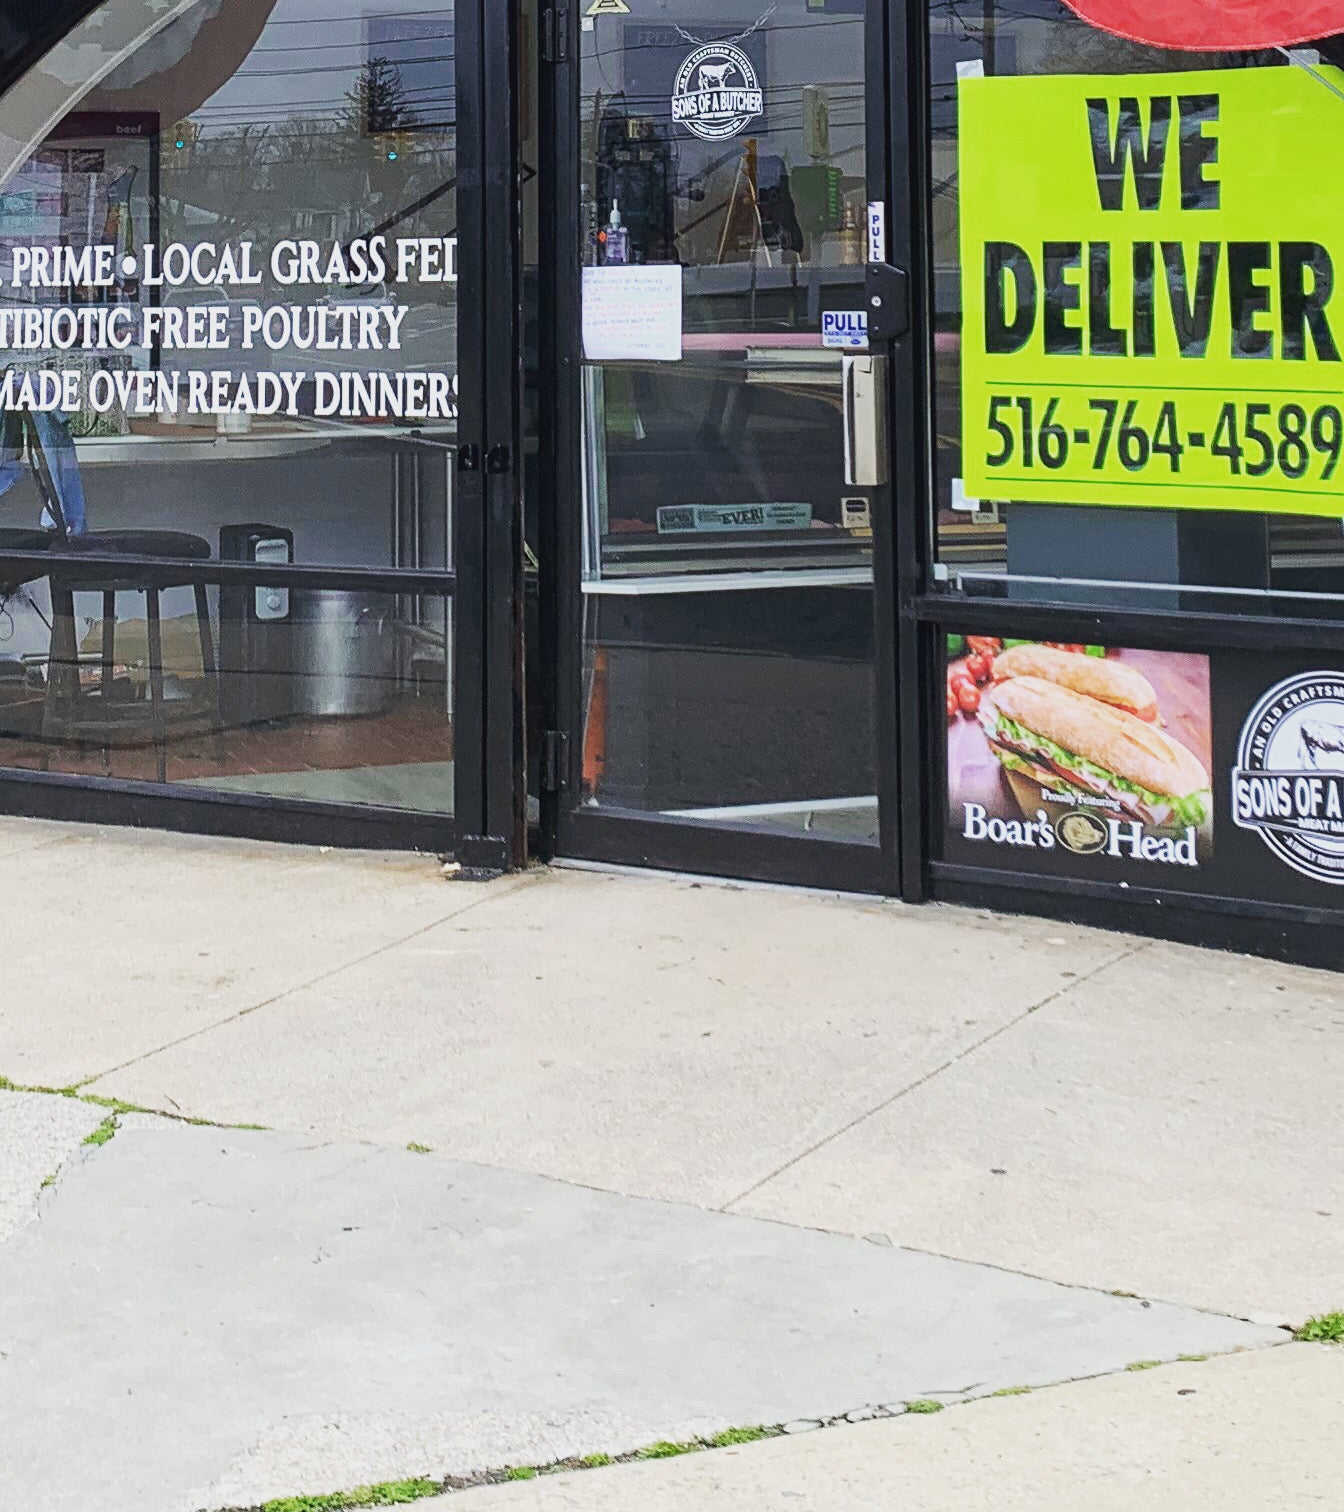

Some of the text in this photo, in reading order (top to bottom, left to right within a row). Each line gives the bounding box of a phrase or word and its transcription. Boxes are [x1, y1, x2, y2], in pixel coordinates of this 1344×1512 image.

[673, 96, 697, 119] SONS
[698, 93, 711, 113] OF
[712, 92, 719, 111] A
[720, 92, 761, 111] BUTCHER
[116, 124, 142, 134] beef
[1086, 94, 1221, 211] WE
[872, 215, 880, 260] PULL
[11, 245, 115, 287] PRIME
[142, 240, 261, 285] LOCAL
[271, 237, 386, 284] GRASS
[824, 314, 867, 331] PULL
[984, 240, 1341, 362] DELIVER
[142, 306, 230, 350] FREE
[243, 305, 408, 350] POULTRY
[89, 369, 178, 414] OVEN
[188, 370, 306, 414] READY
[986, 395, 1343, 481] 516-764-4589
[1252, 735, 1265, 759] AN
[1262, 709, 1284, 732] OLD
[1041, 788, 1123, 811] Proudly Featuring
[1238, 777, 1292, 818] SONS
[1294, 778, 1324, 816] OF
[1326, 780, 1342, 819] A
[962, 802, 1199, 866] Boar's Head
[1298, 817, 1330, 831] MEAT
